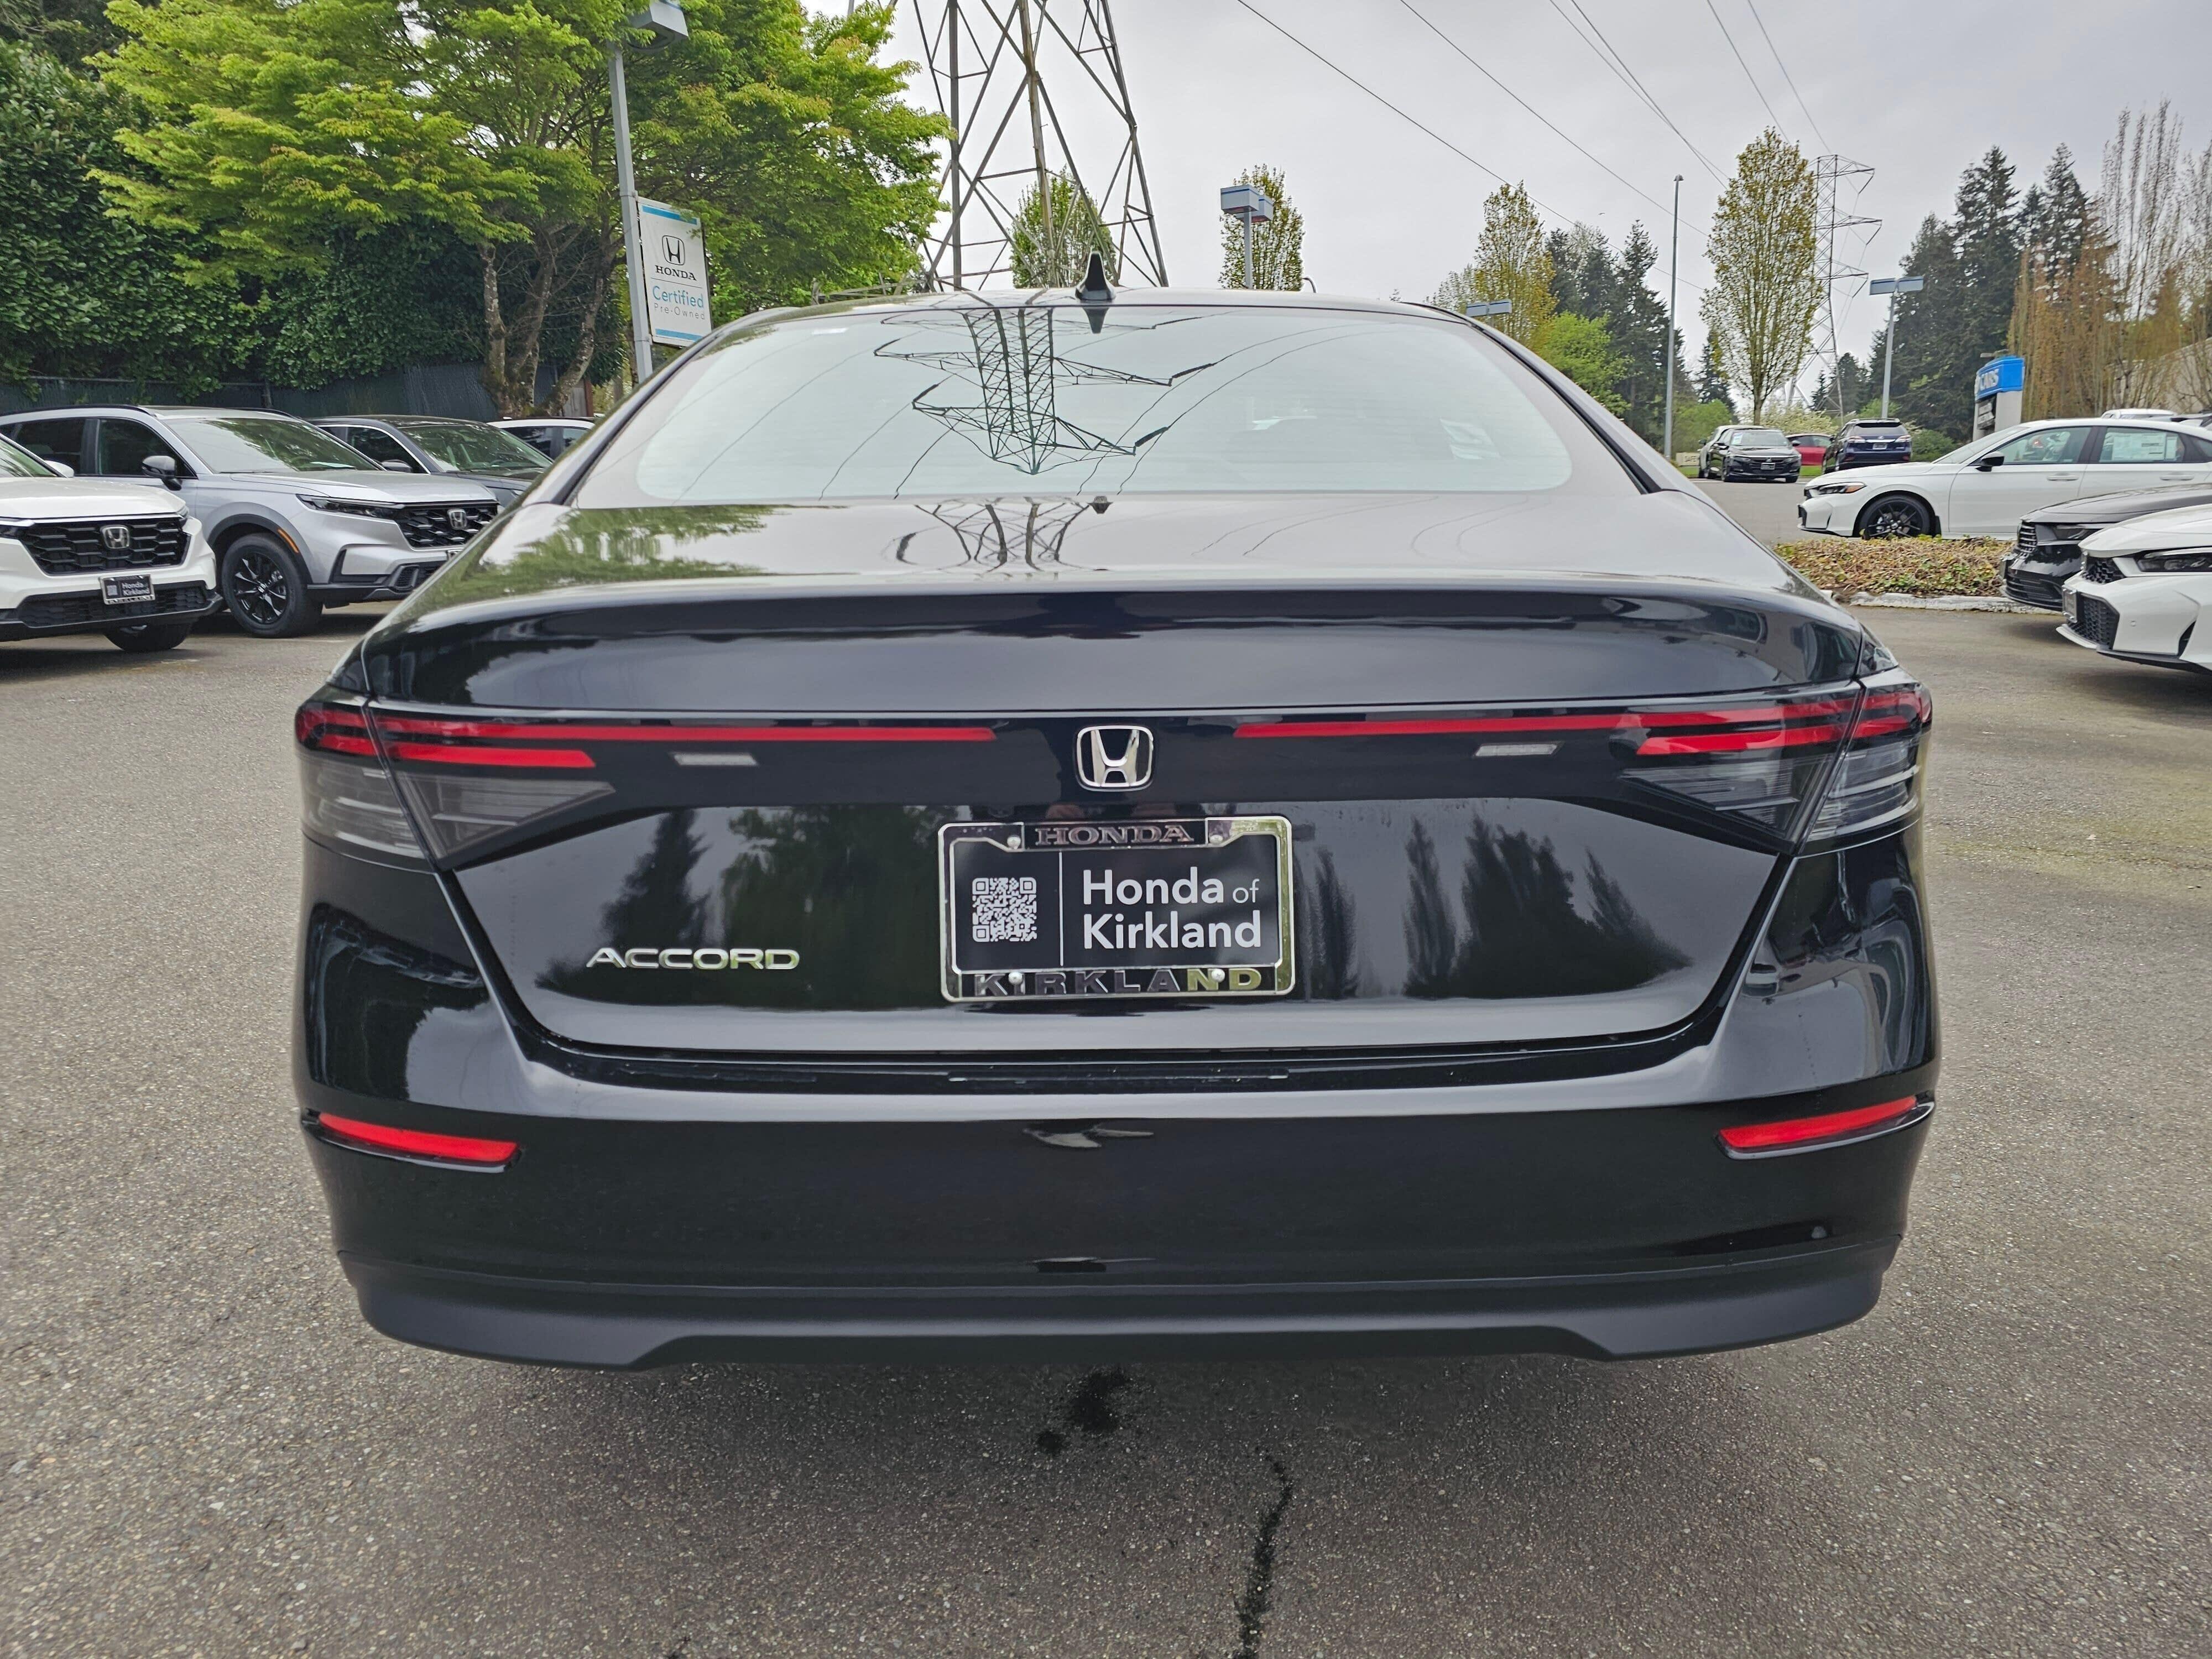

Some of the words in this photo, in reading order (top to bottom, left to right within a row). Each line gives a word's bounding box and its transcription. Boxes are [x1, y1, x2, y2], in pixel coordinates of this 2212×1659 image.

[655, 265, 697, 281] HONDA
[653, 285, 704, 308] Certified
[654, 302, 705, 320] Pre-Owned
[1034, 825, 1195, 846] HONDA
[1083, 866, 1224, 905] Honda
[1232, 878, 1261, 904] of
[1083, 910, 1261, 950] Kirkland
[586, 947, 800, 970] ACCORD
